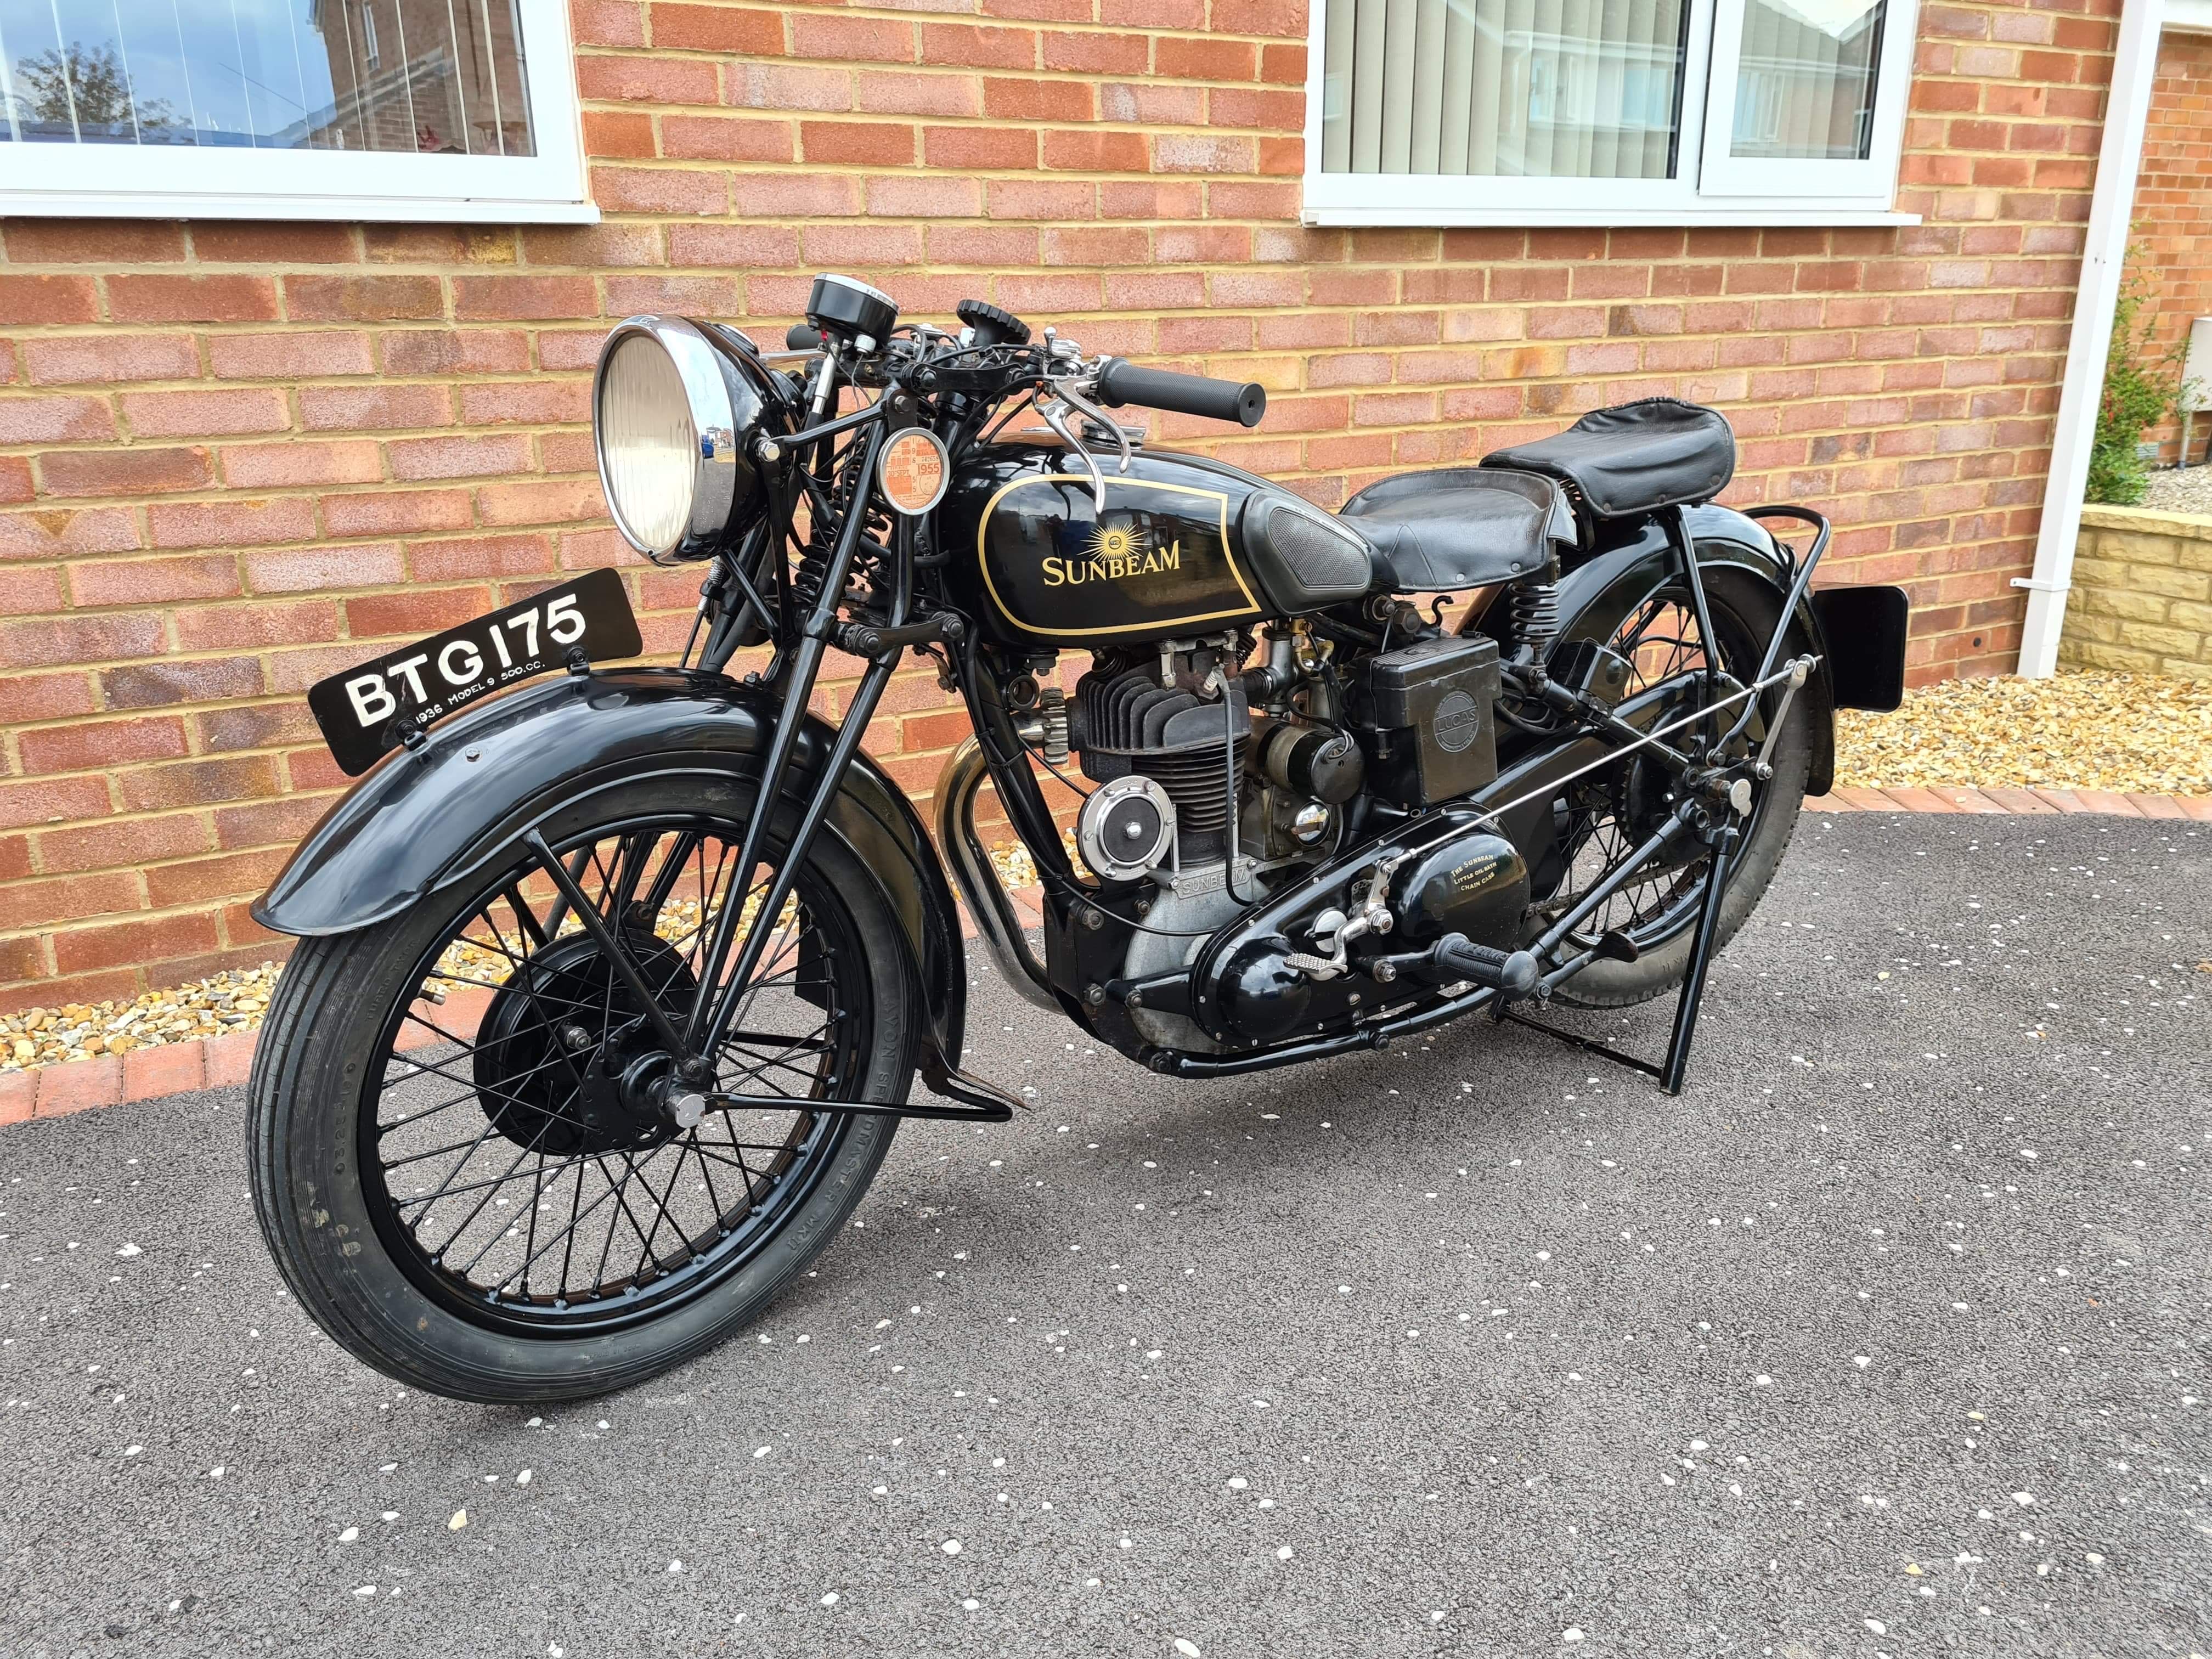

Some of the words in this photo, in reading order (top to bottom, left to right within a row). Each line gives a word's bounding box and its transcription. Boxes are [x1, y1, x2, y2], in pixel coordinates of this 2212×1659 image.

[918, 464, 939, 475] 1955
[1041, 539, 1180, 586] SUNBEAM
[416, 705, 443, 724] 1936
[448, 682, 486, 706] MODEL
[487, 678, 495, 689] 9
[1437, 709, 1475, 731] LUCAS
[1183, 868, 1246, 894] SUNBEM
[1451, 866, 1463, 877] THE
[1454, 873, 1474, 884] LITTLE
[1484, 861, 1497, 871] BATH
[1460, 881, 1481, 890] CHAIN
[1481, 872, 1495, 884] CASE
[882, 999, 899, 1060] AVON
[825, 1073, 890, 1205] SPEDMASTER
